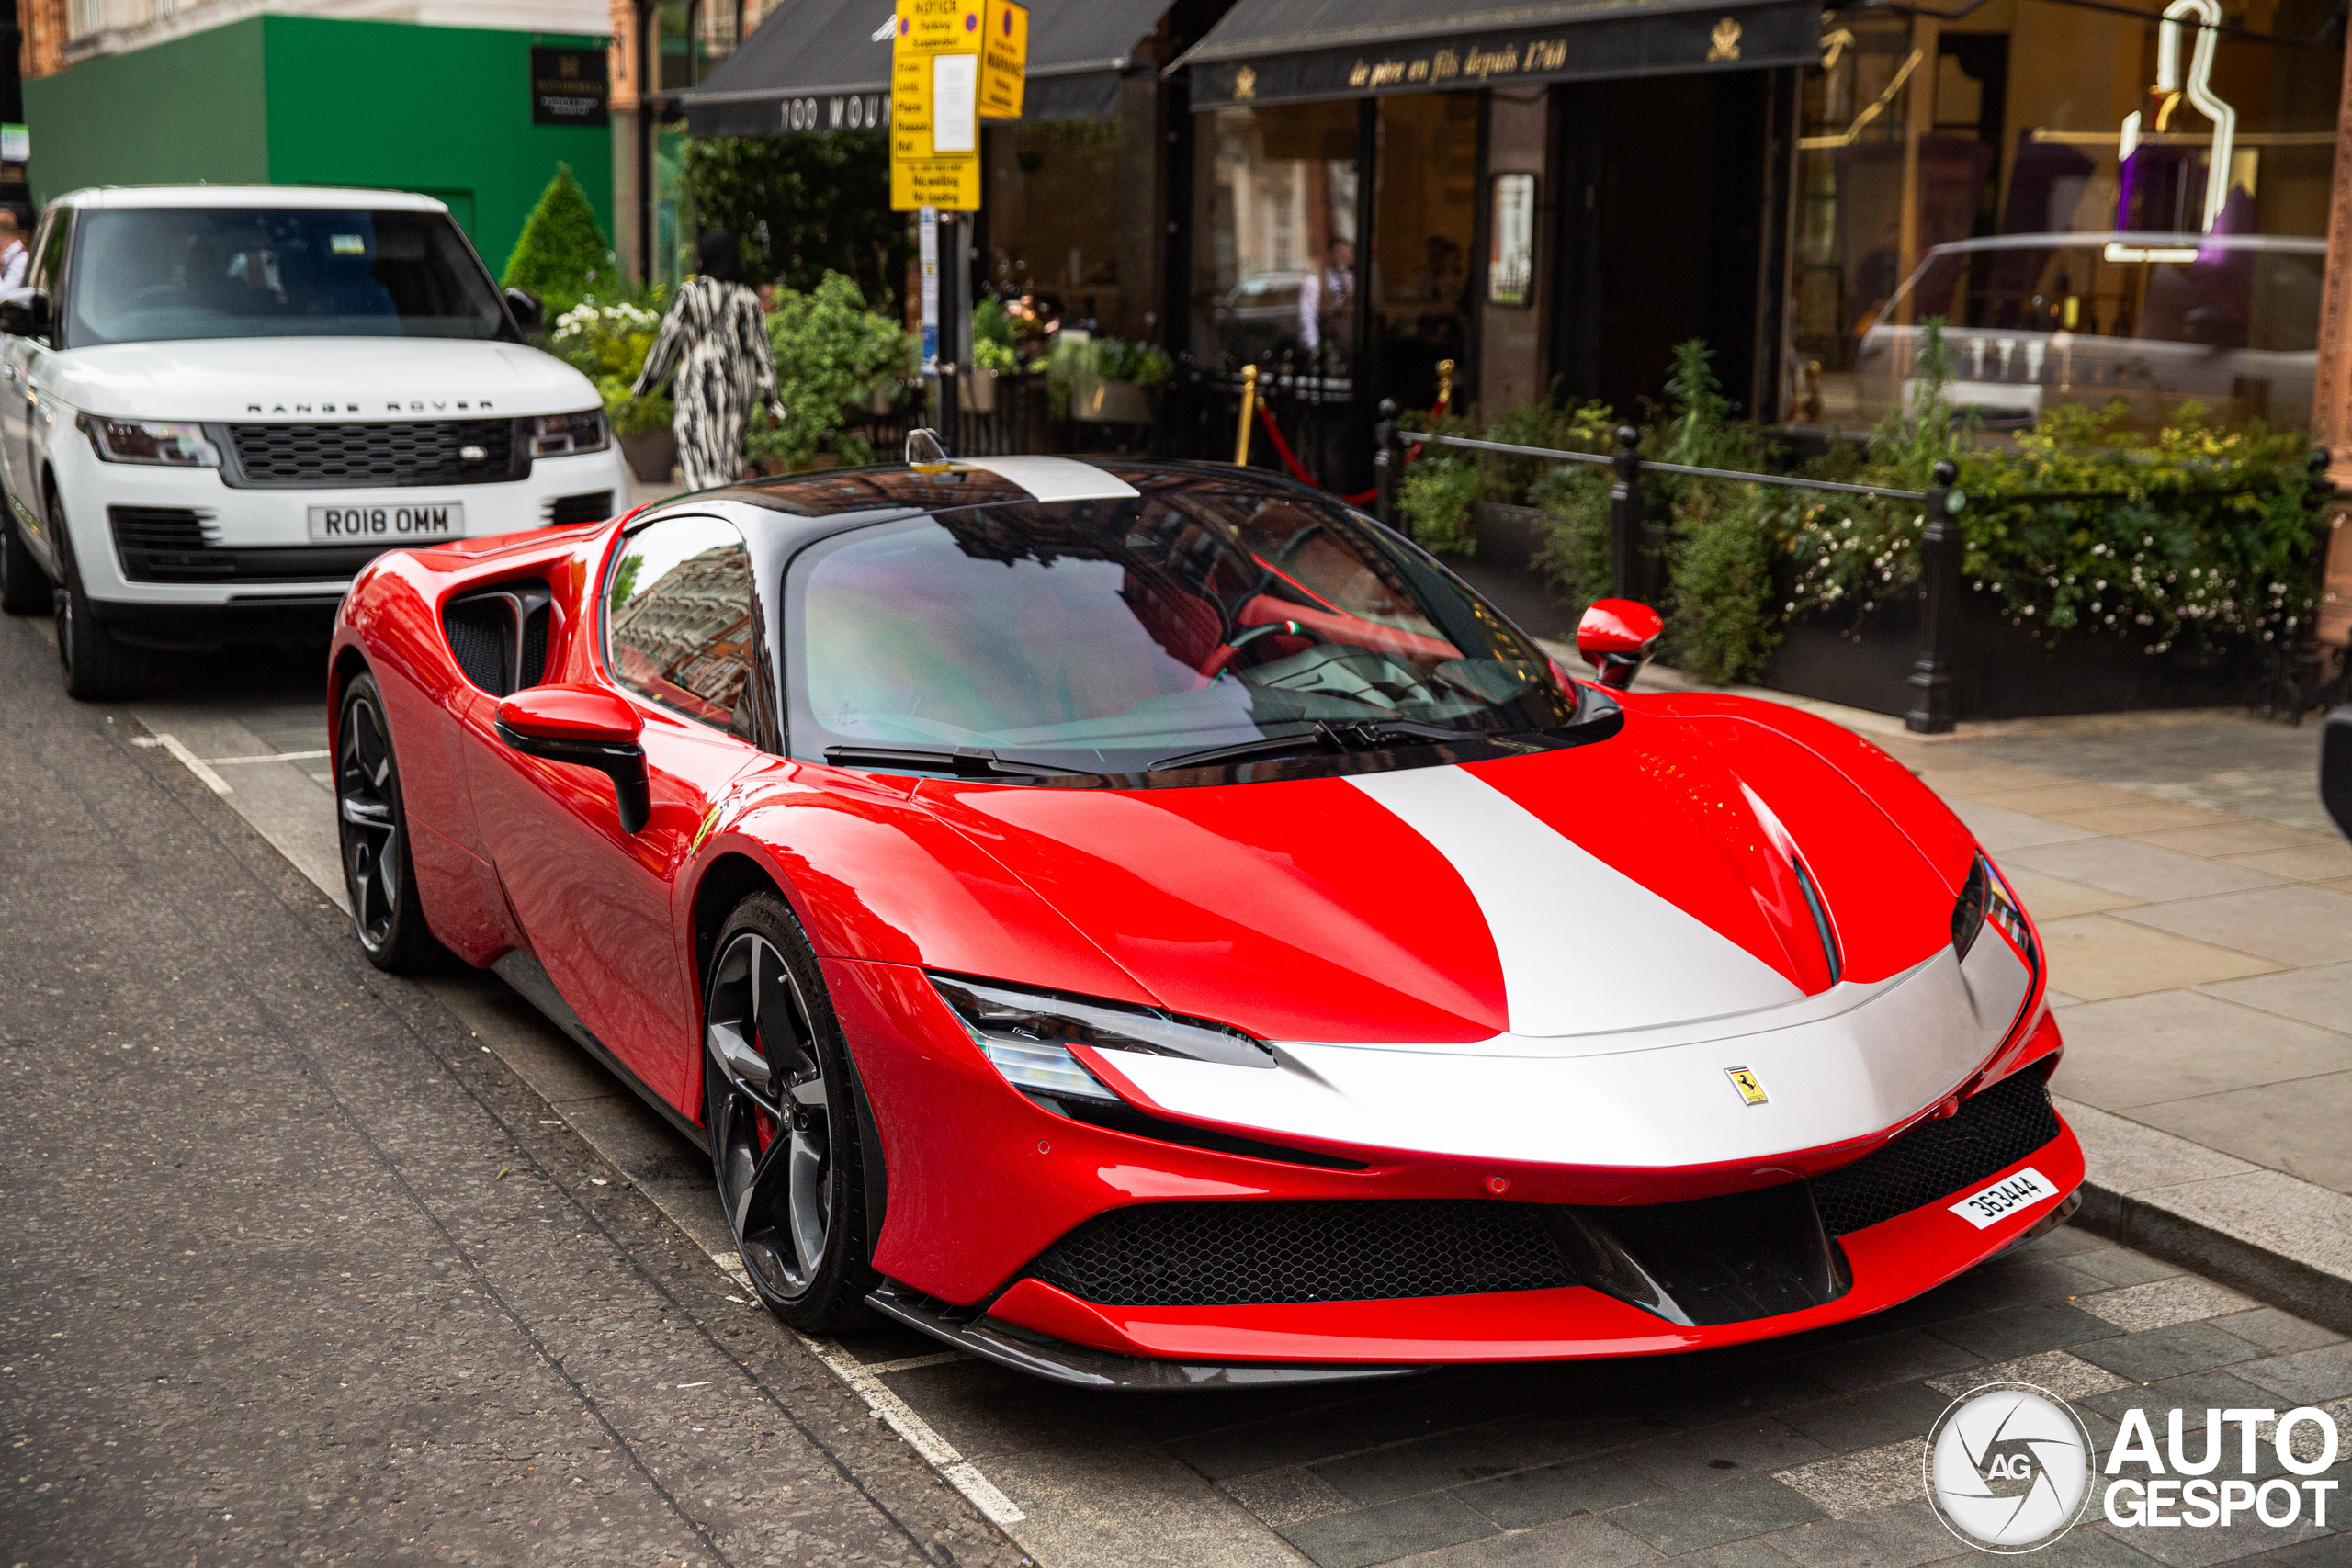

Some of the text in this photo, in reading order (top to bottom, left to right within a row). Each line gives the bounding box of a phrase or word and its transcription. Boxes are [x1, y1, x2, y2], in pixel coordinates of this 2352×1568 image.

[915, 0, 956, 14] NOTICE
[1348, 58, 1370, 86] de
[1408, 59, 1429, 81] en
[1428, 48, 1460, 86] fils
[1464, 42, 1519, 82] depuis
[1522, 39, 1567, 72] 1760
[779, 97, 817, 130] 100
[247, 400, 493, 413] RANGE ROVER
[325, 507, 448, 535] RO18 OMM
[1968, 1176, 2041, 1217] 363444
